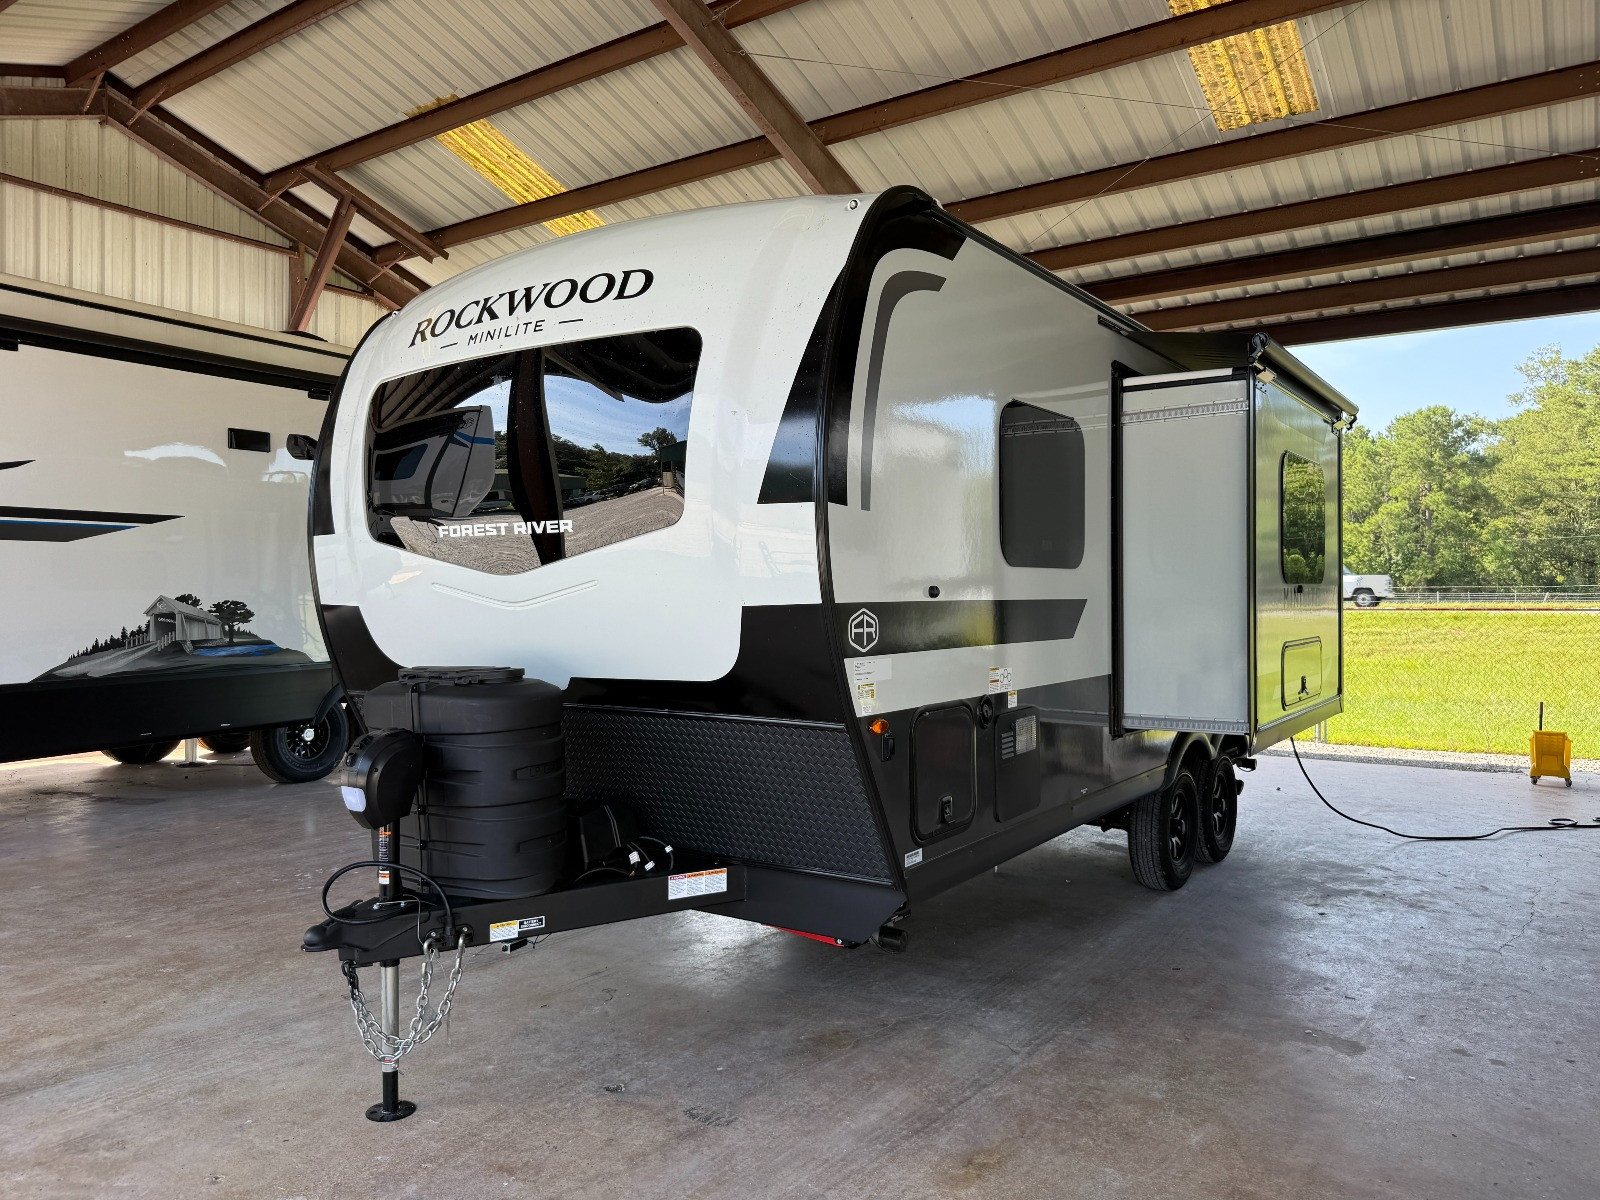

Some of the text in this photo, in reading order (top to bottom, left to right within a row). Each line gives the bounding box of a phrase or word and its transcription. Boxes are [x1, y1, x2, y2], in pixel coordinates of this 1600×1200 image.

[407, 268, 655, 349] ROCKWOOD
[467, 319, 546, 346] MINILITE
[438, 519, 574, 538] FOREST RIVER
